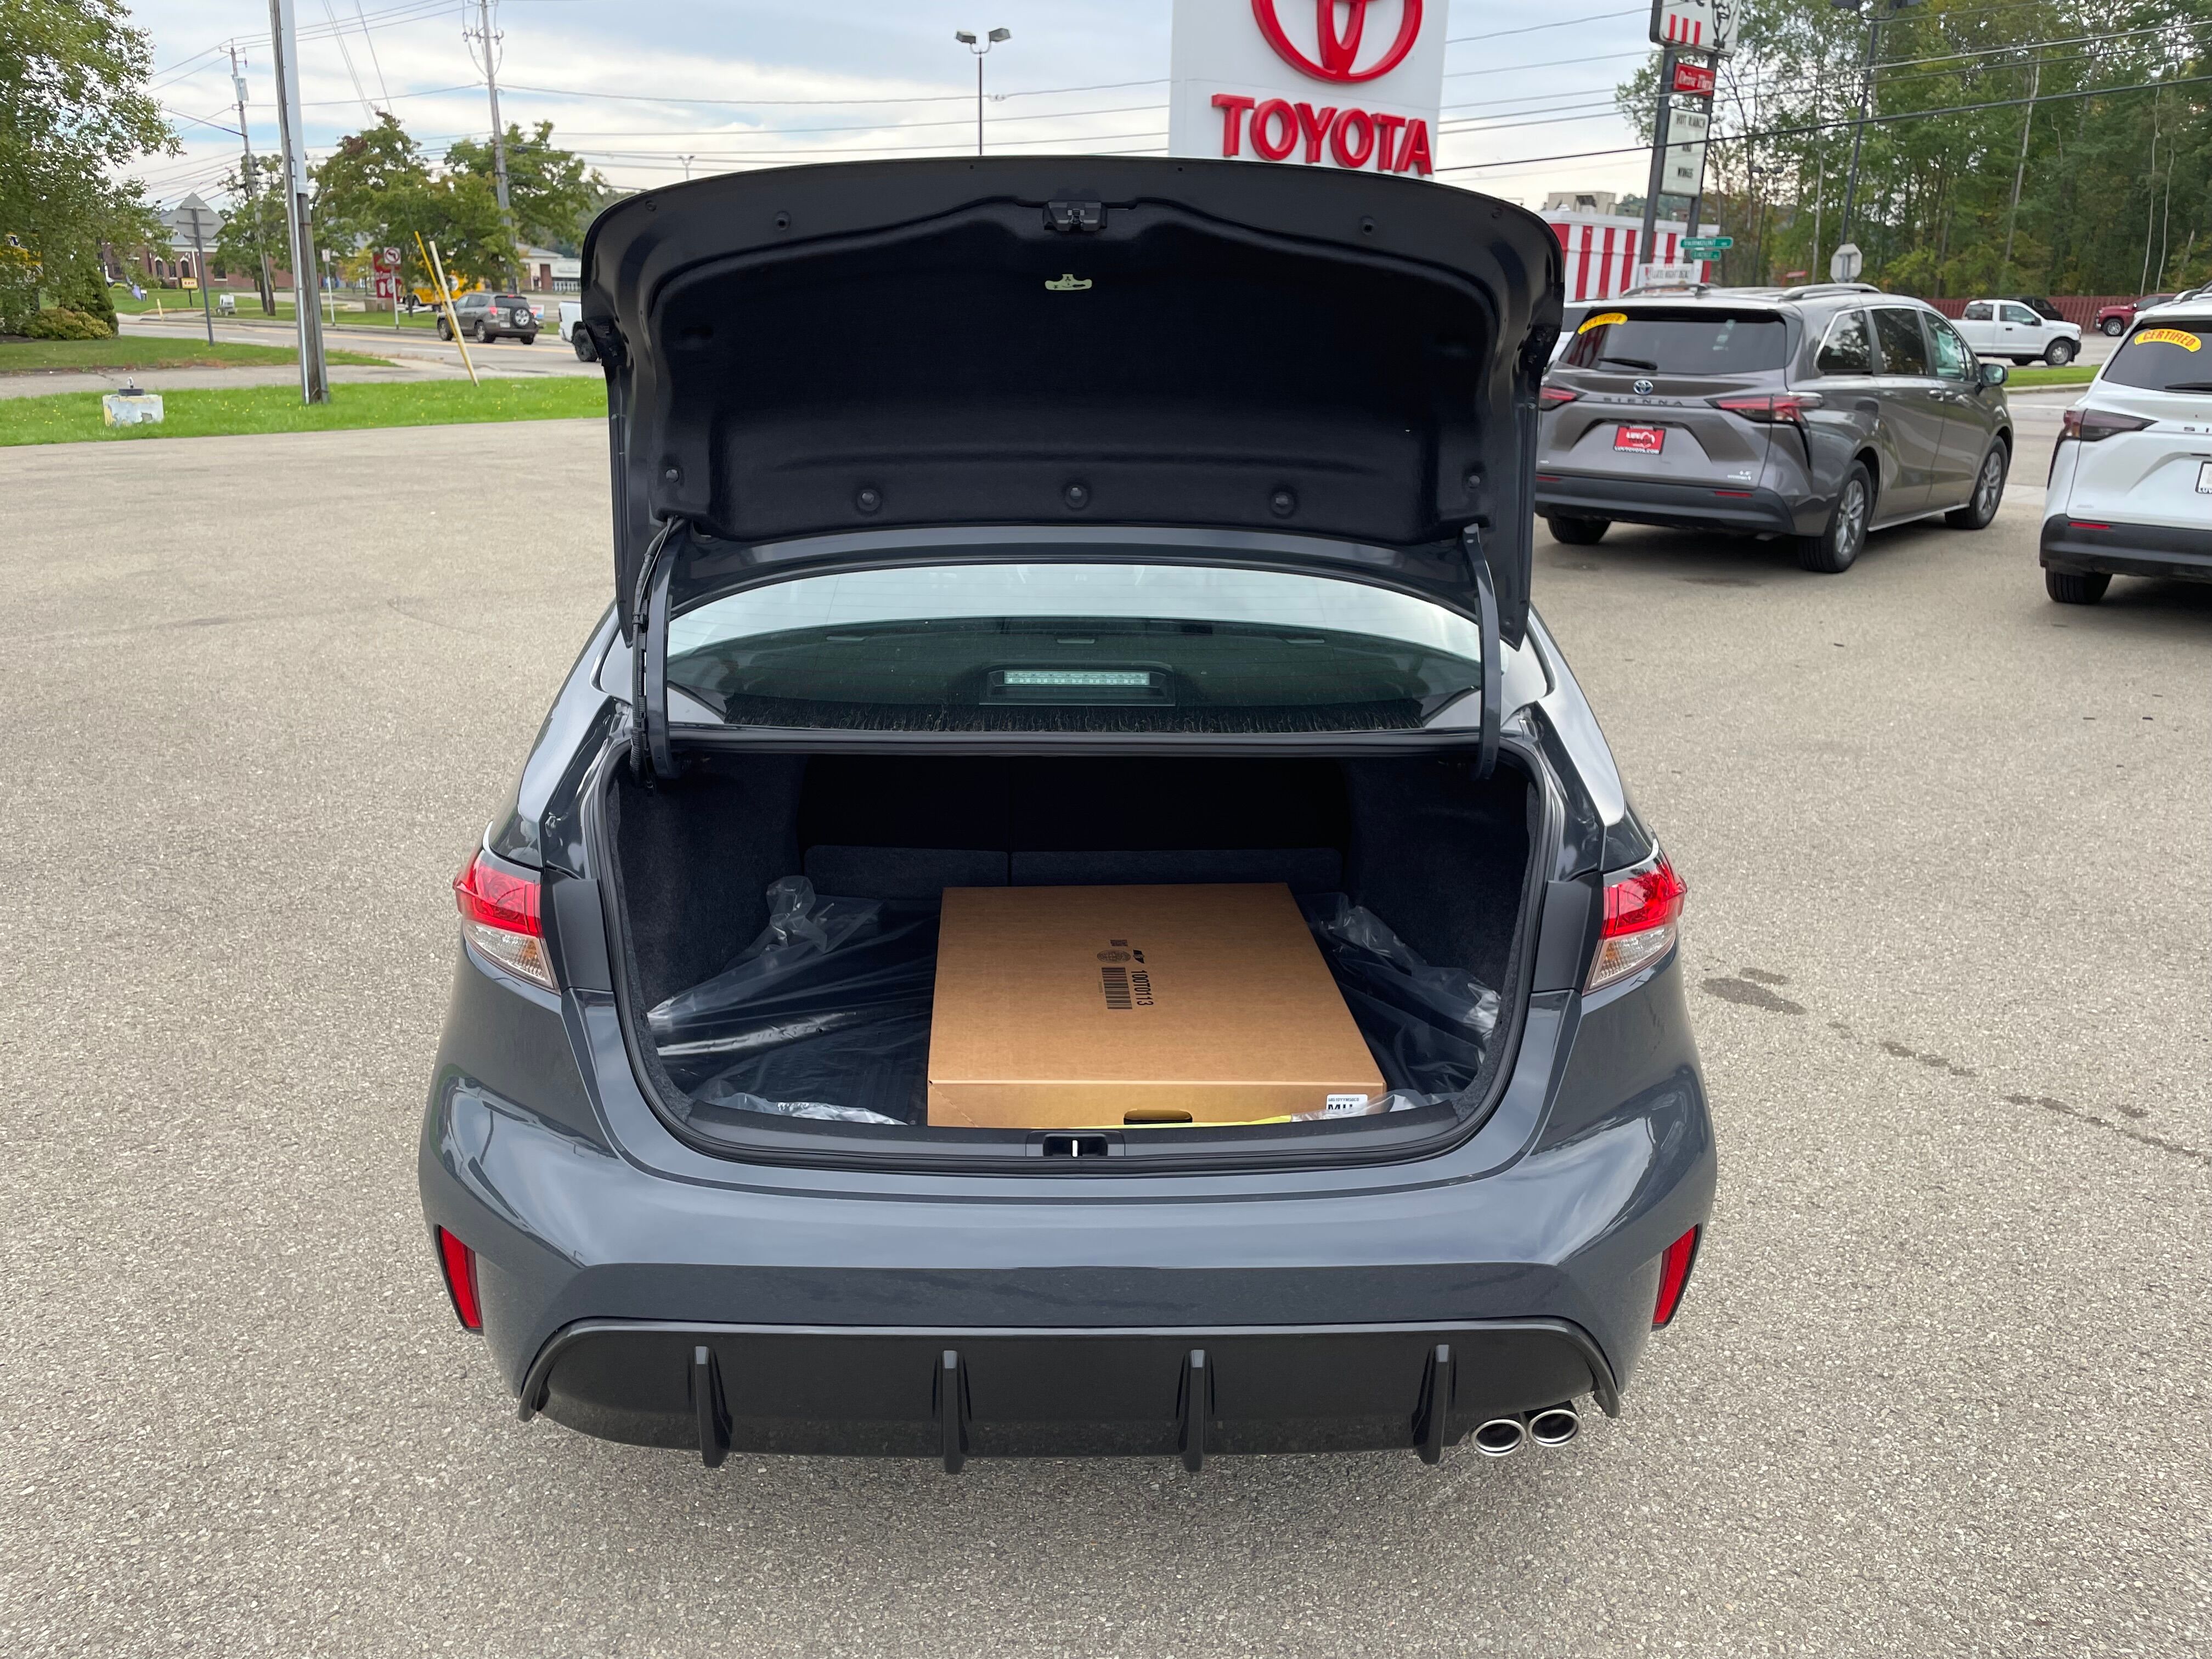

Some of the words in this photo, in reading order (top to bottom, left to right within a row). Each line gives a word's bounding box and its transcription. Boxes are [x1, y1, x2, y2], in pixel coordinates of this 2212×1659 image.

[1211, 93, 1432, 176] TOYOTA
[2143, 331, 2196, 347] CERTIFIED
[1604, 397, 1684, 407] SIENNA
[1131, 970, 1154, 1006] 100T0113
